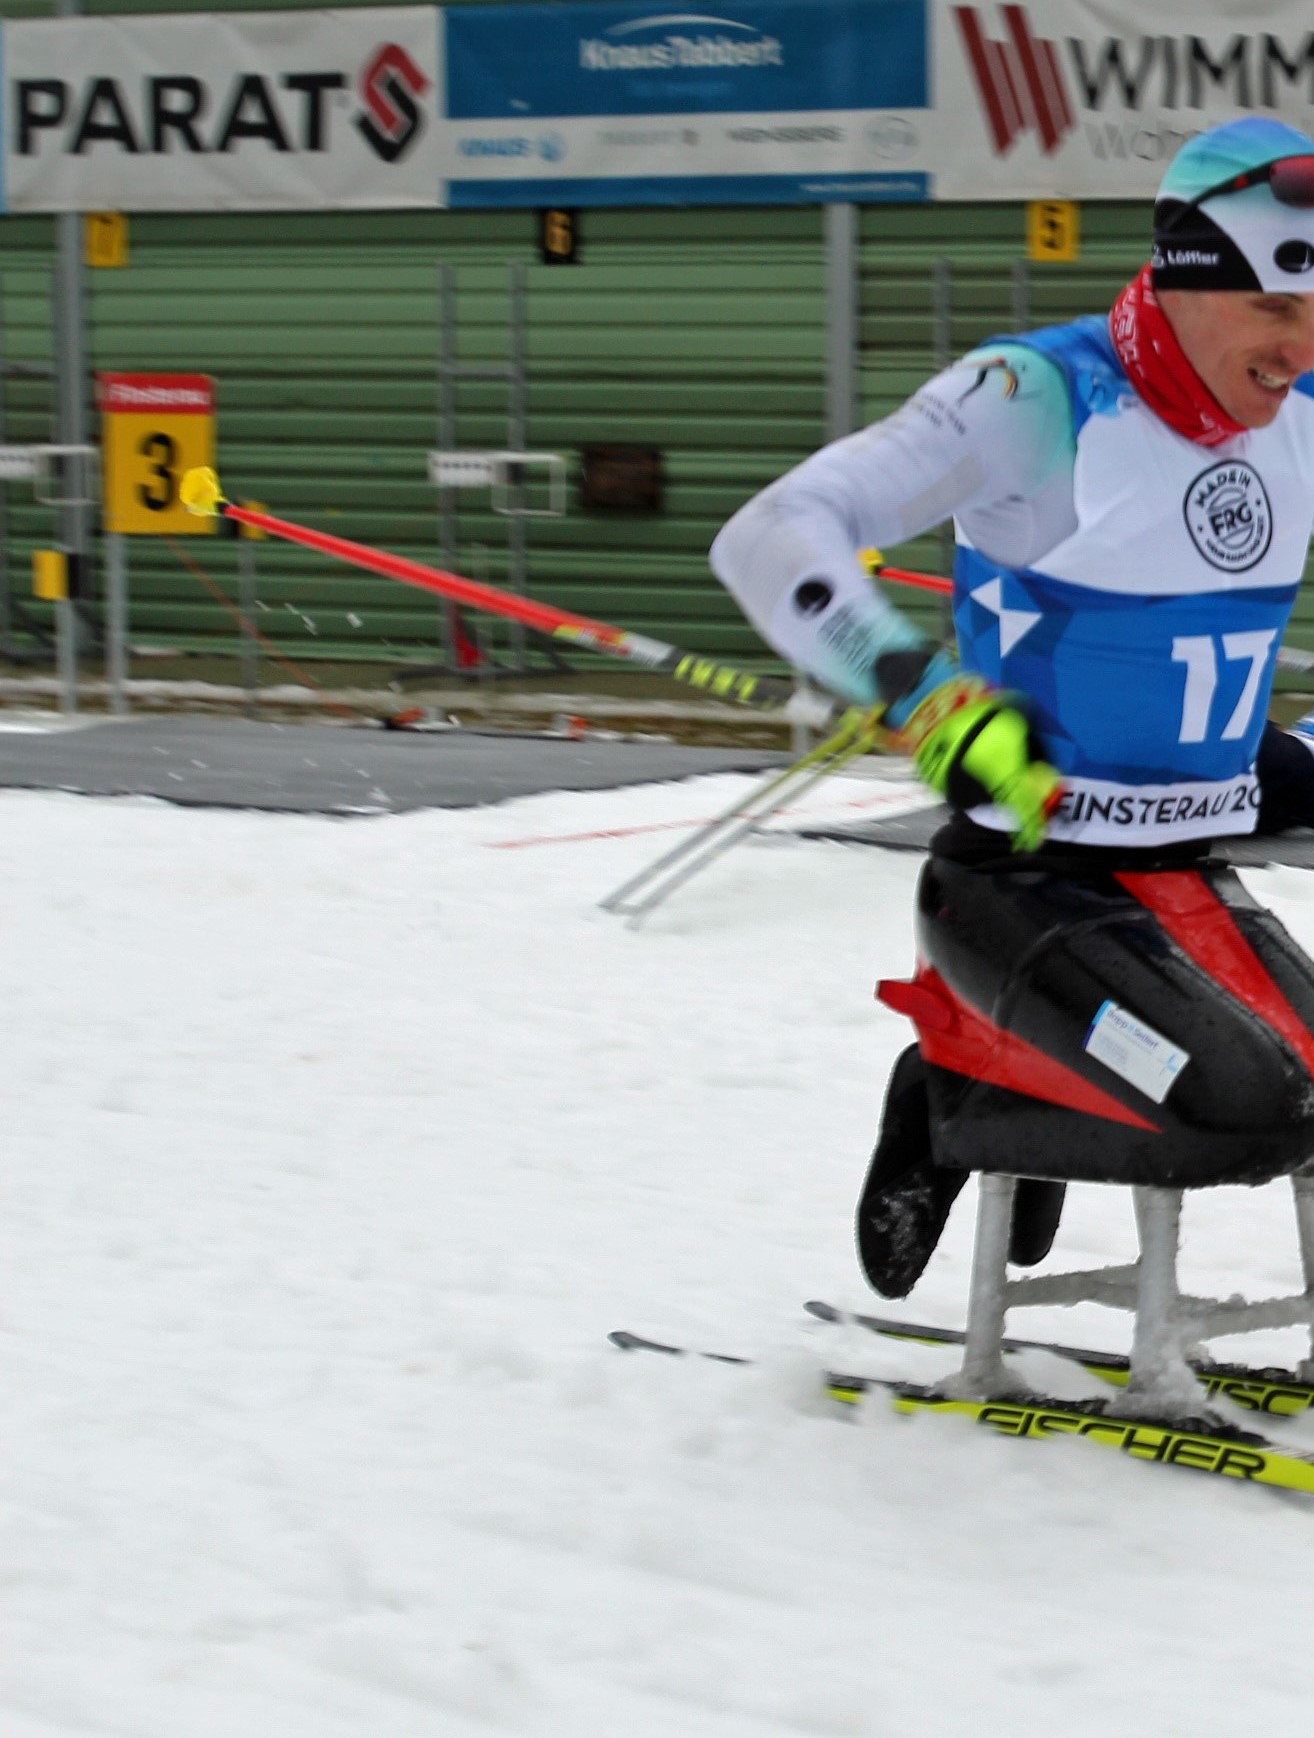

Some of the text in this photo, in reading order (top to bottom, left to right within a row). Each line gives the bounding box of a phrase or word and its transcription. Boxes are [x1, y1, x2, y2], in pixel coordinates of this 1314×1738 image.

[13, 73, 347, 155] PARAT
[137, 432, 181, 512] 3
[1196, 468, 1237, 508] MADE
[1210, 501, 1253, 536] FRG
[1171, 628, 1277, 744] 17
